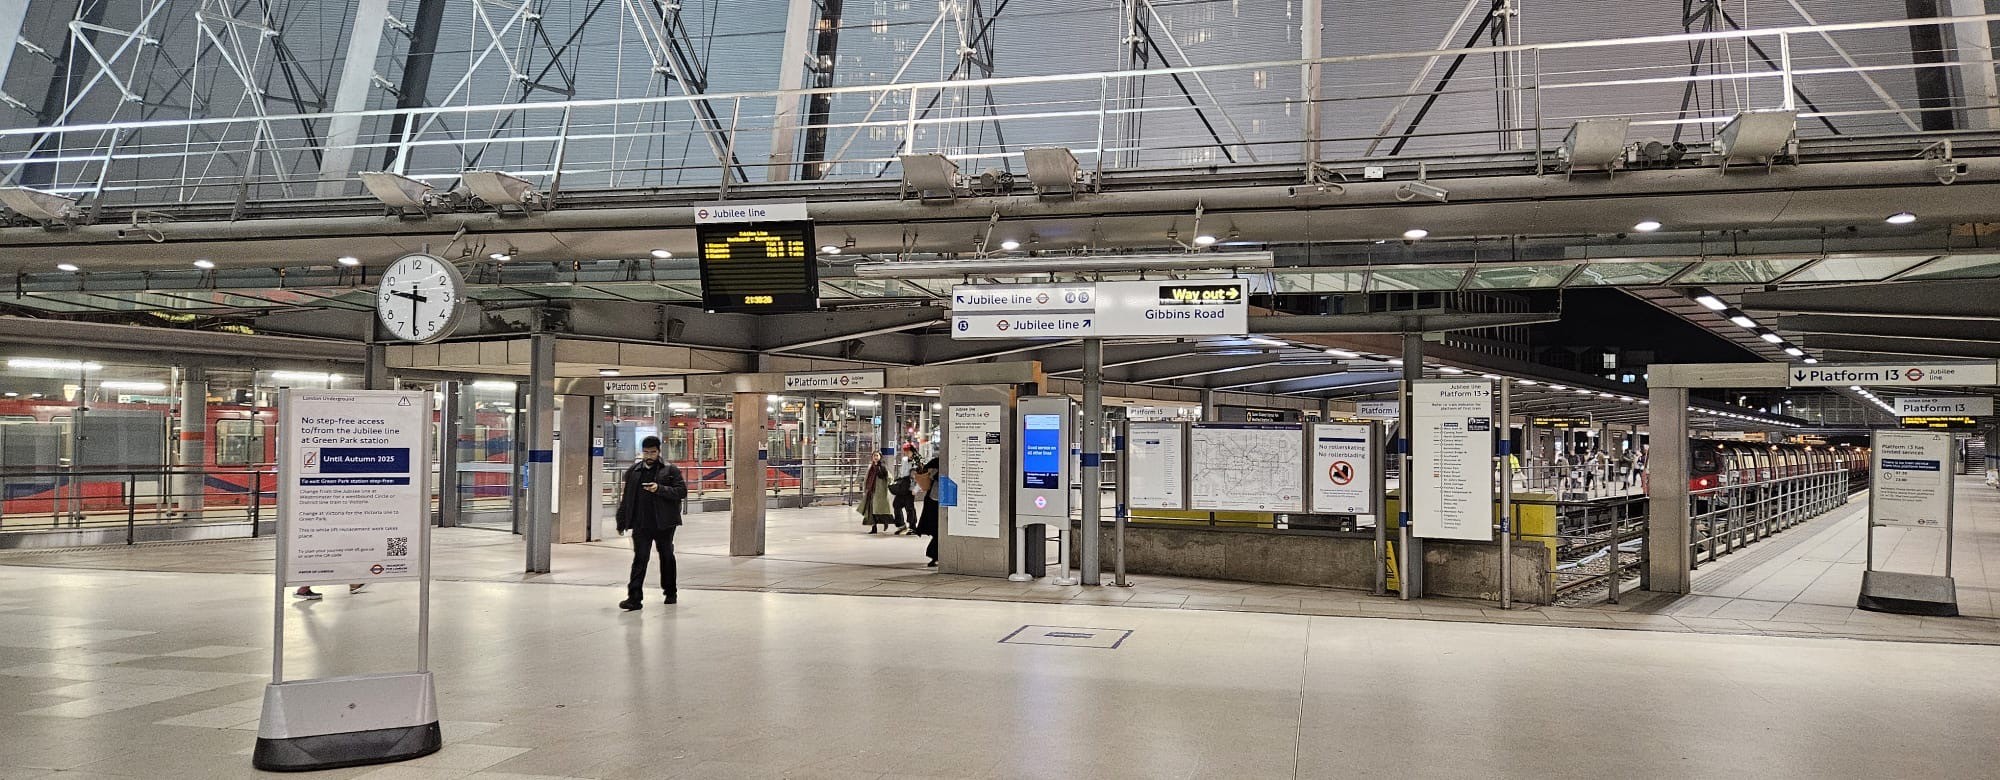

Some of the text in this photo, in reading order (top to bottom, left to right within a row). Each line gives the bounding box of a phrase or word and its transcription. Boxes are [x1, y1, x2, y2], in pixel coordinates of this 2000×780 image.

[713, 208, 766, 218] Jubilee line
[413, 260, 421, 270] 12
[440, 276, 446, 285] 2
[384, 294, 390, 303] 9
[443, 292, 450, 302] 3
[968, 295, 1008, 304] Jubilee
[1011, 295, 1032, 304] line
[1172, 289, 1225, 300] Way out
[388, 310, 394, 319] 8
[440, 309, 445, 319] 4
[1145, 308, 1224, 319] Gibbins Road
[398, 322, 404, 331] 7
[428, 321, 434, 331] 5
[1014, 320, 1054, 330] Jubilee
[1058, 320, 1079, 329] line
[1810, 370, 1899, 381] Platform 13
[641, 382, 646, 390] 15
[795, 377, 838, 386] Platform 14
